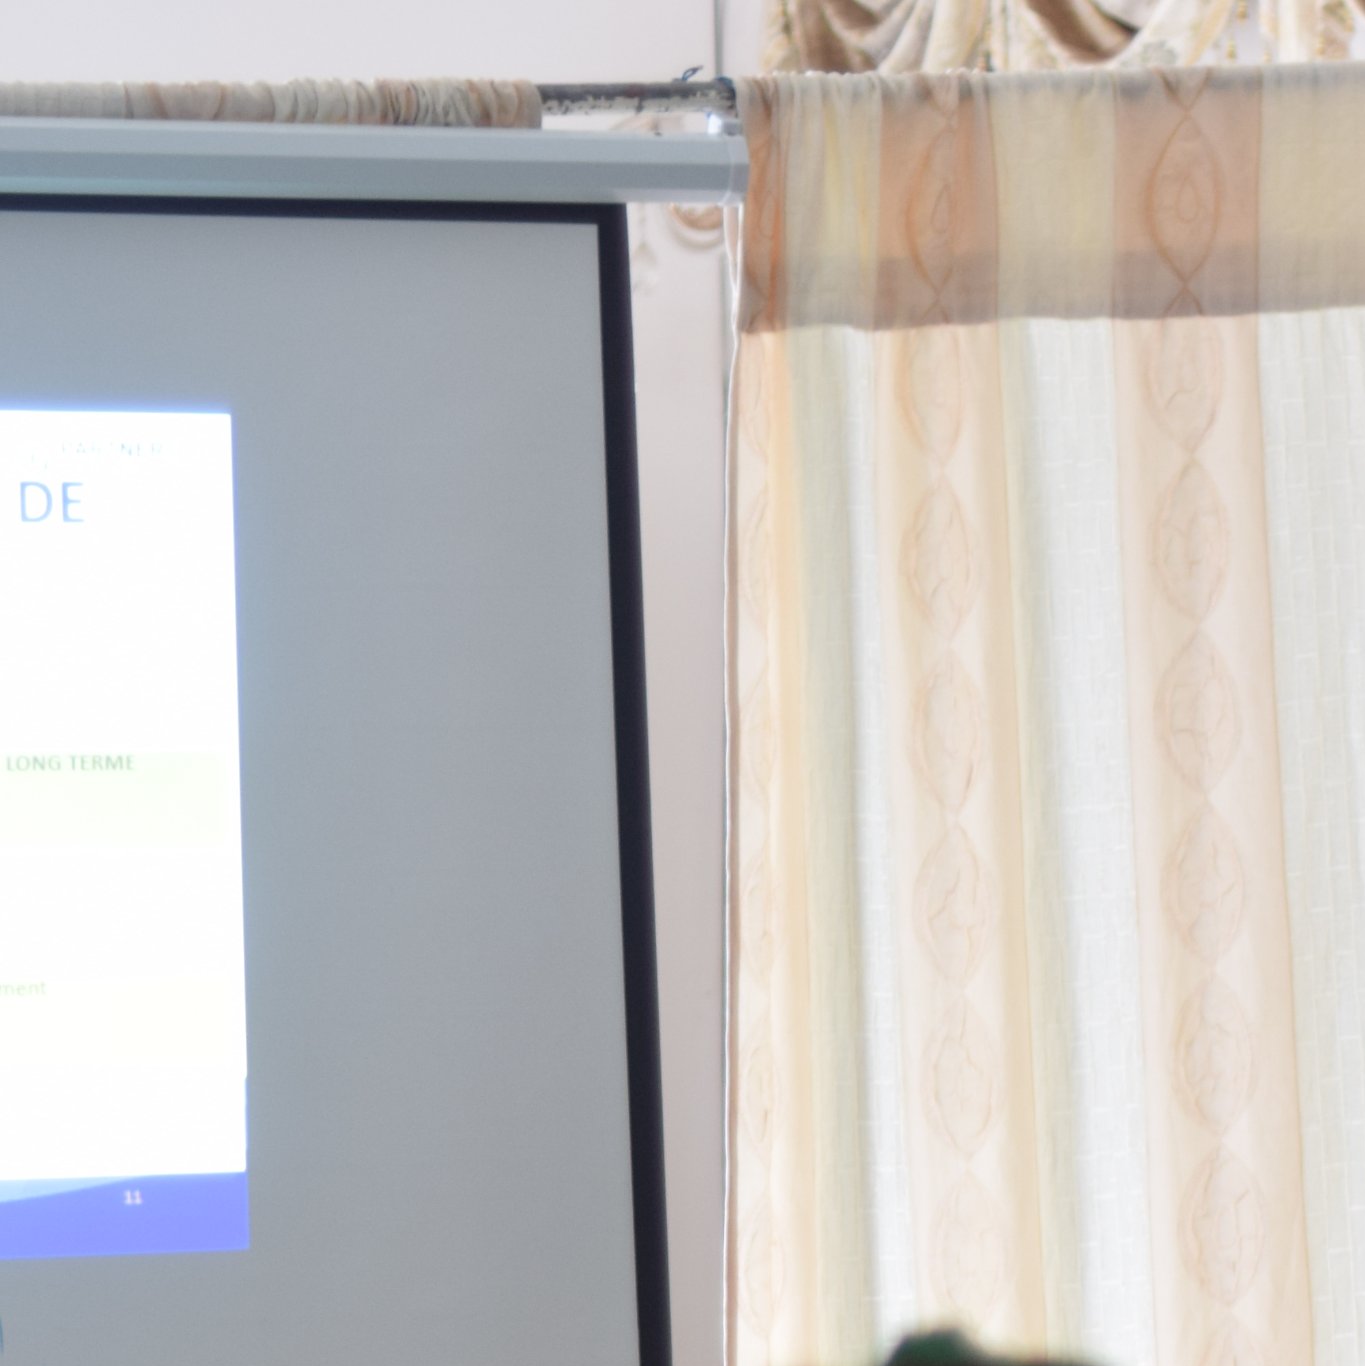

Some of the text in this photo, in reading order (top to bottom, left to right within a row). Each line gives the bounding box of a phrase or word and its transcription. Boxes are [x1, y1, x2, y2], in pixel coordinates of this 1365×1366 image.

[20, 481, 85, 523] DE
[5, 754, 135, 772] LONG TERME
[123, 1189, 143, 1206] 11
